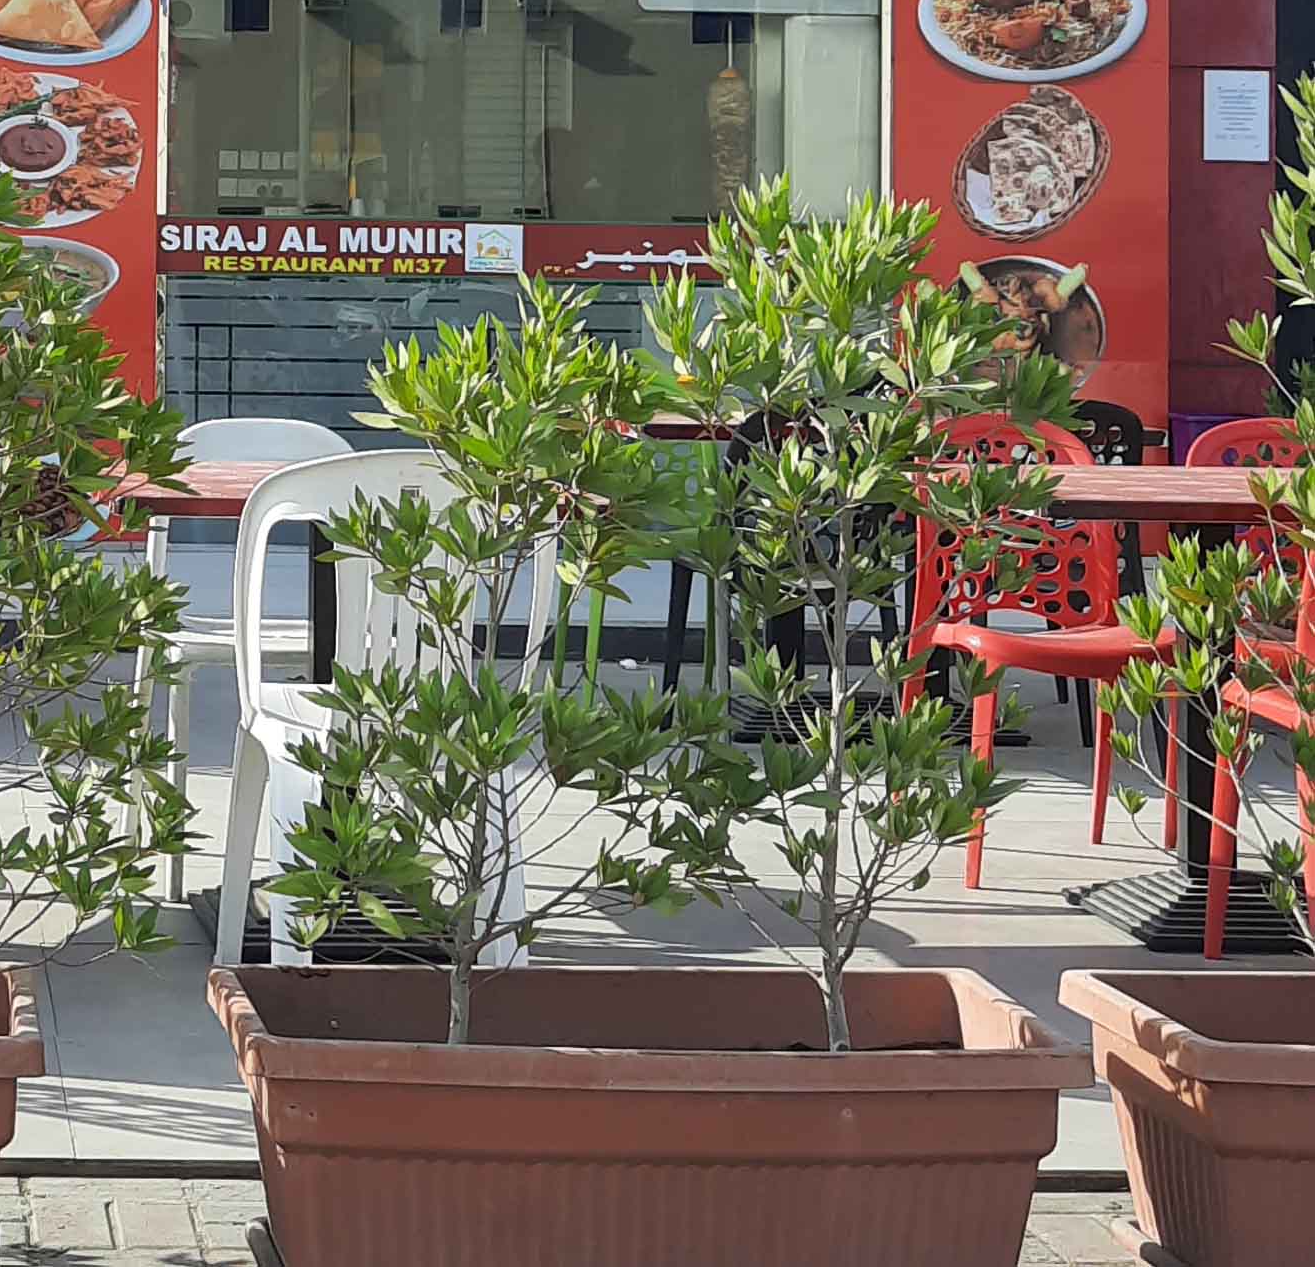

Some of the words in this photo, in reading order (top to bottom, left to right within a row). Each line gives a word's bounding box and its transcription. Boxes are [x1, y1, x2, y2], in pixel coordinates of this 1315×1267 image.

[160, 224, 267, 252] SIRAJ
[278, 226, 327, 253] AL
[339, 227, 464, 255] MUNIR
[203, 255, 384, 274] RESTAURANT
[392, 257, 448, 275] M37
